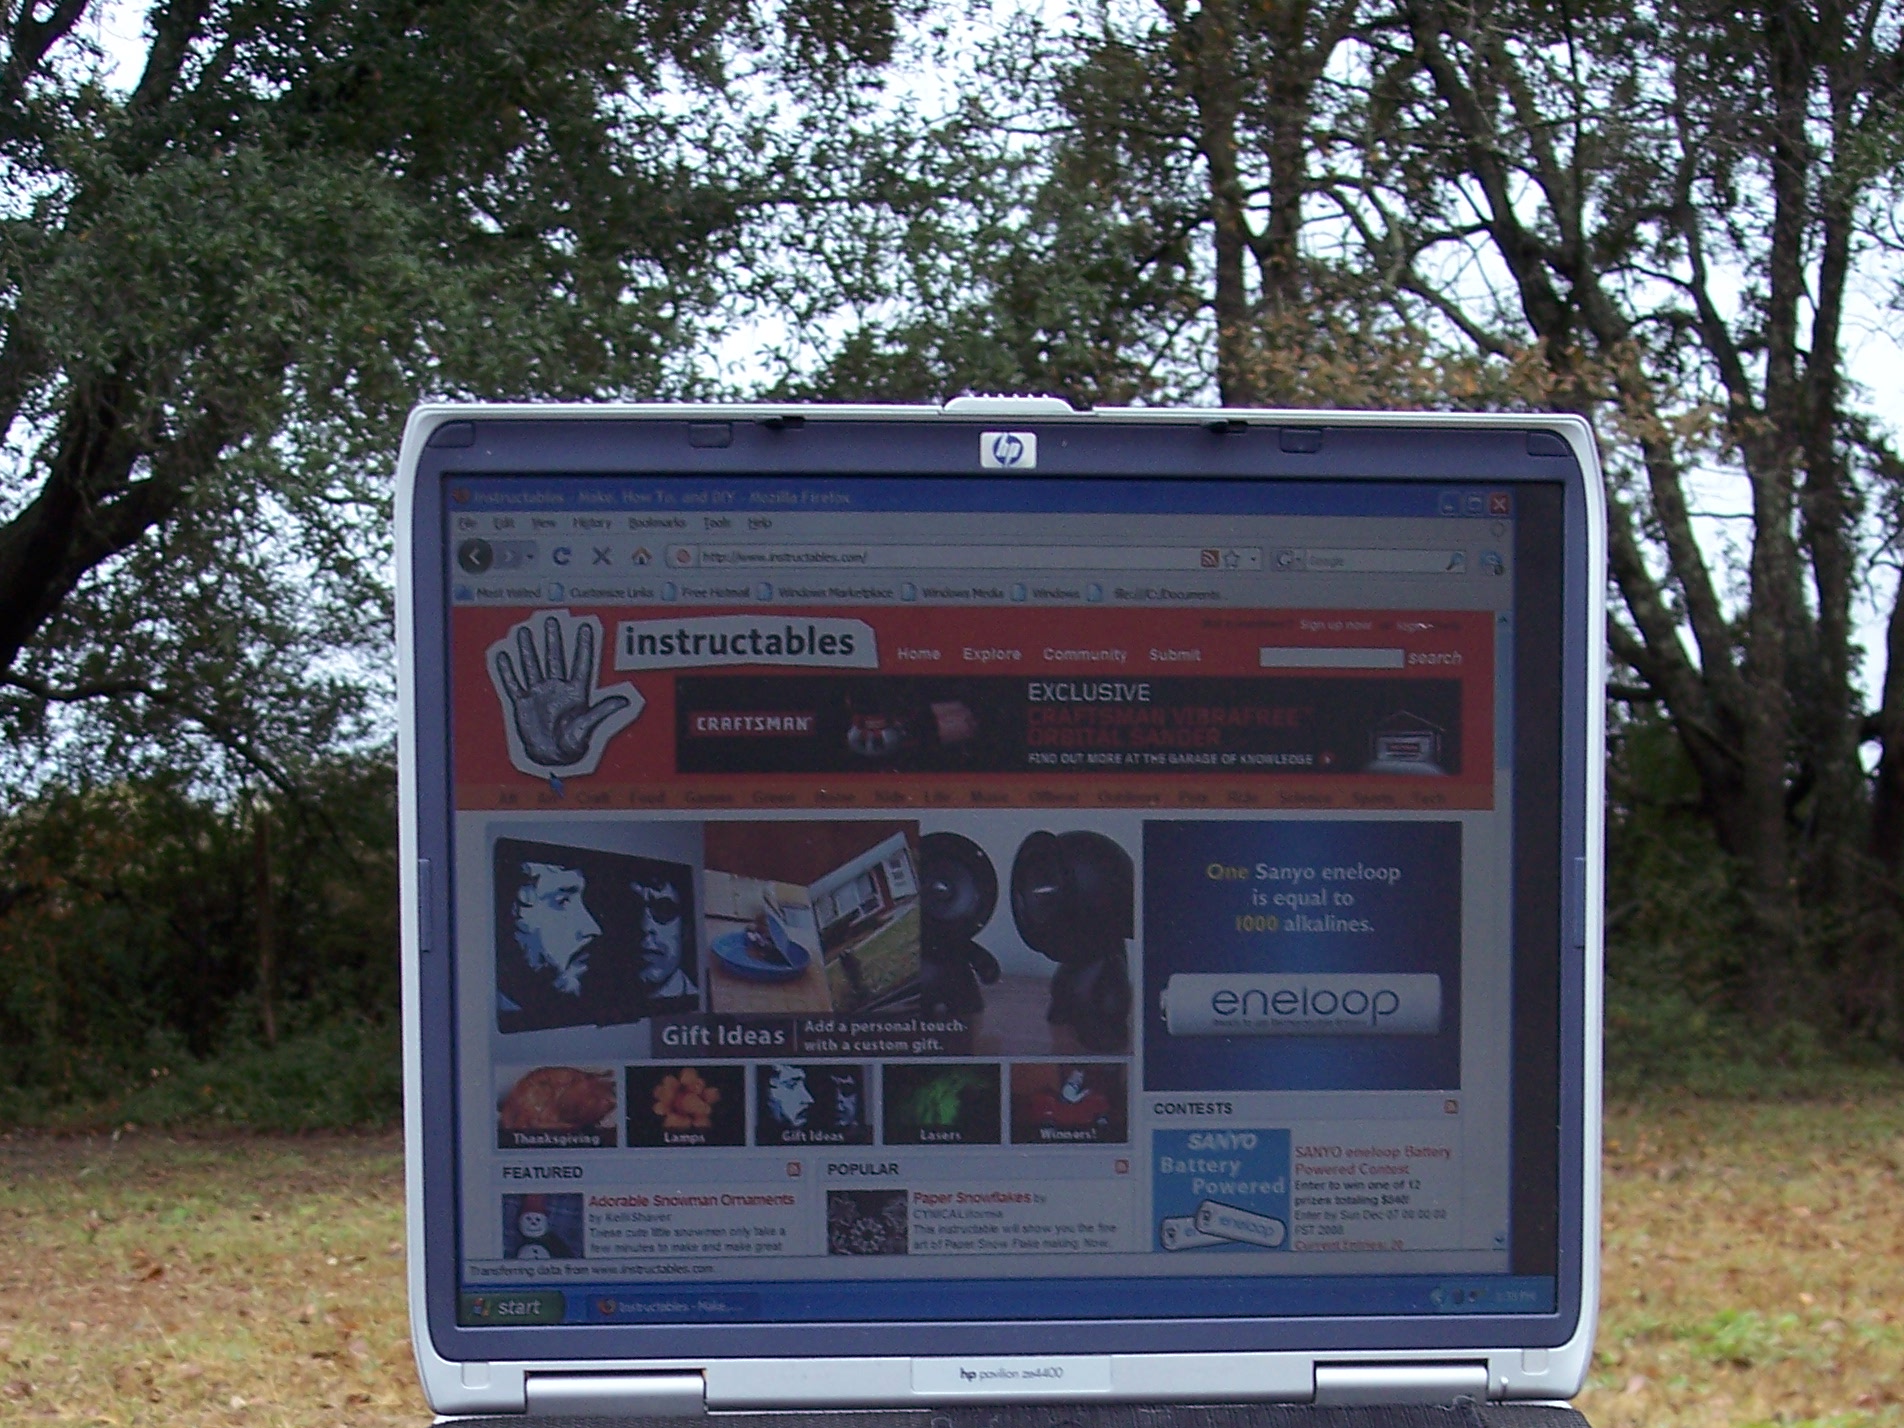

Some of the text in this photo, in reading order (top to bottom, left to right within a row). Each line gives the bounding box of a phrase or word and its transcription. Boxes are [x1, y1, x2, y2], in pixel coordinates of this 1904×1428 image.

[573, 517, 611, 530] History
[626, 625, 856, 657] instructables
[897, 648, 1202, 663] Home Explore Community Submit
[1407, 651, 1462, 664] search
[1027, 683, 1151, 701] EXCLUSIVE
[696, 716, 813, 732] CRAFTSMAN
[1060, 753, 1085, 765] OUT
[1124, 753, 1141, 765] AT
[1220, 753, 1238, 765] OF
[1205, 862, 1402, 885] One Sanyo eneloop
[1251, 888, 1355, 910] is equal to
[1235, 914, 1375, 933] 1000 alkalines.
[1211, 988, 1402, 1025] eneloop
[805, 1020, 834, 1033] Add
[837, 1023, 848, 1033] a
[851, 1019, 917, 1036] personal
[661, 1024, 786, 1047] Gift Ideas
[804, 1038, 838, 1052] with
[842, 1041, 851, 1051] a
[854, 1039, 909, 1051] custom
[1153, 1102, 1233, 1115] CONTESTS
[663, 1132, 706, 1145] Lamps
[1295, 1146, 1342, 1159] SANYO
[502, 1166, 583, 1179] FEATURED
[827, 1163, 899, 1176] POPULAR
[1160, 1157, 1242, 1177] Battery
[1295, 1163, 1356, 1176] Powered
[1192, 1176, 1286, 1196] Powered
[589, 1193, 796, 1207] Adorable Snowman Ornaments
[498, 1301, 542, 1315] start
[960, 1368, 977, 1382] hp
